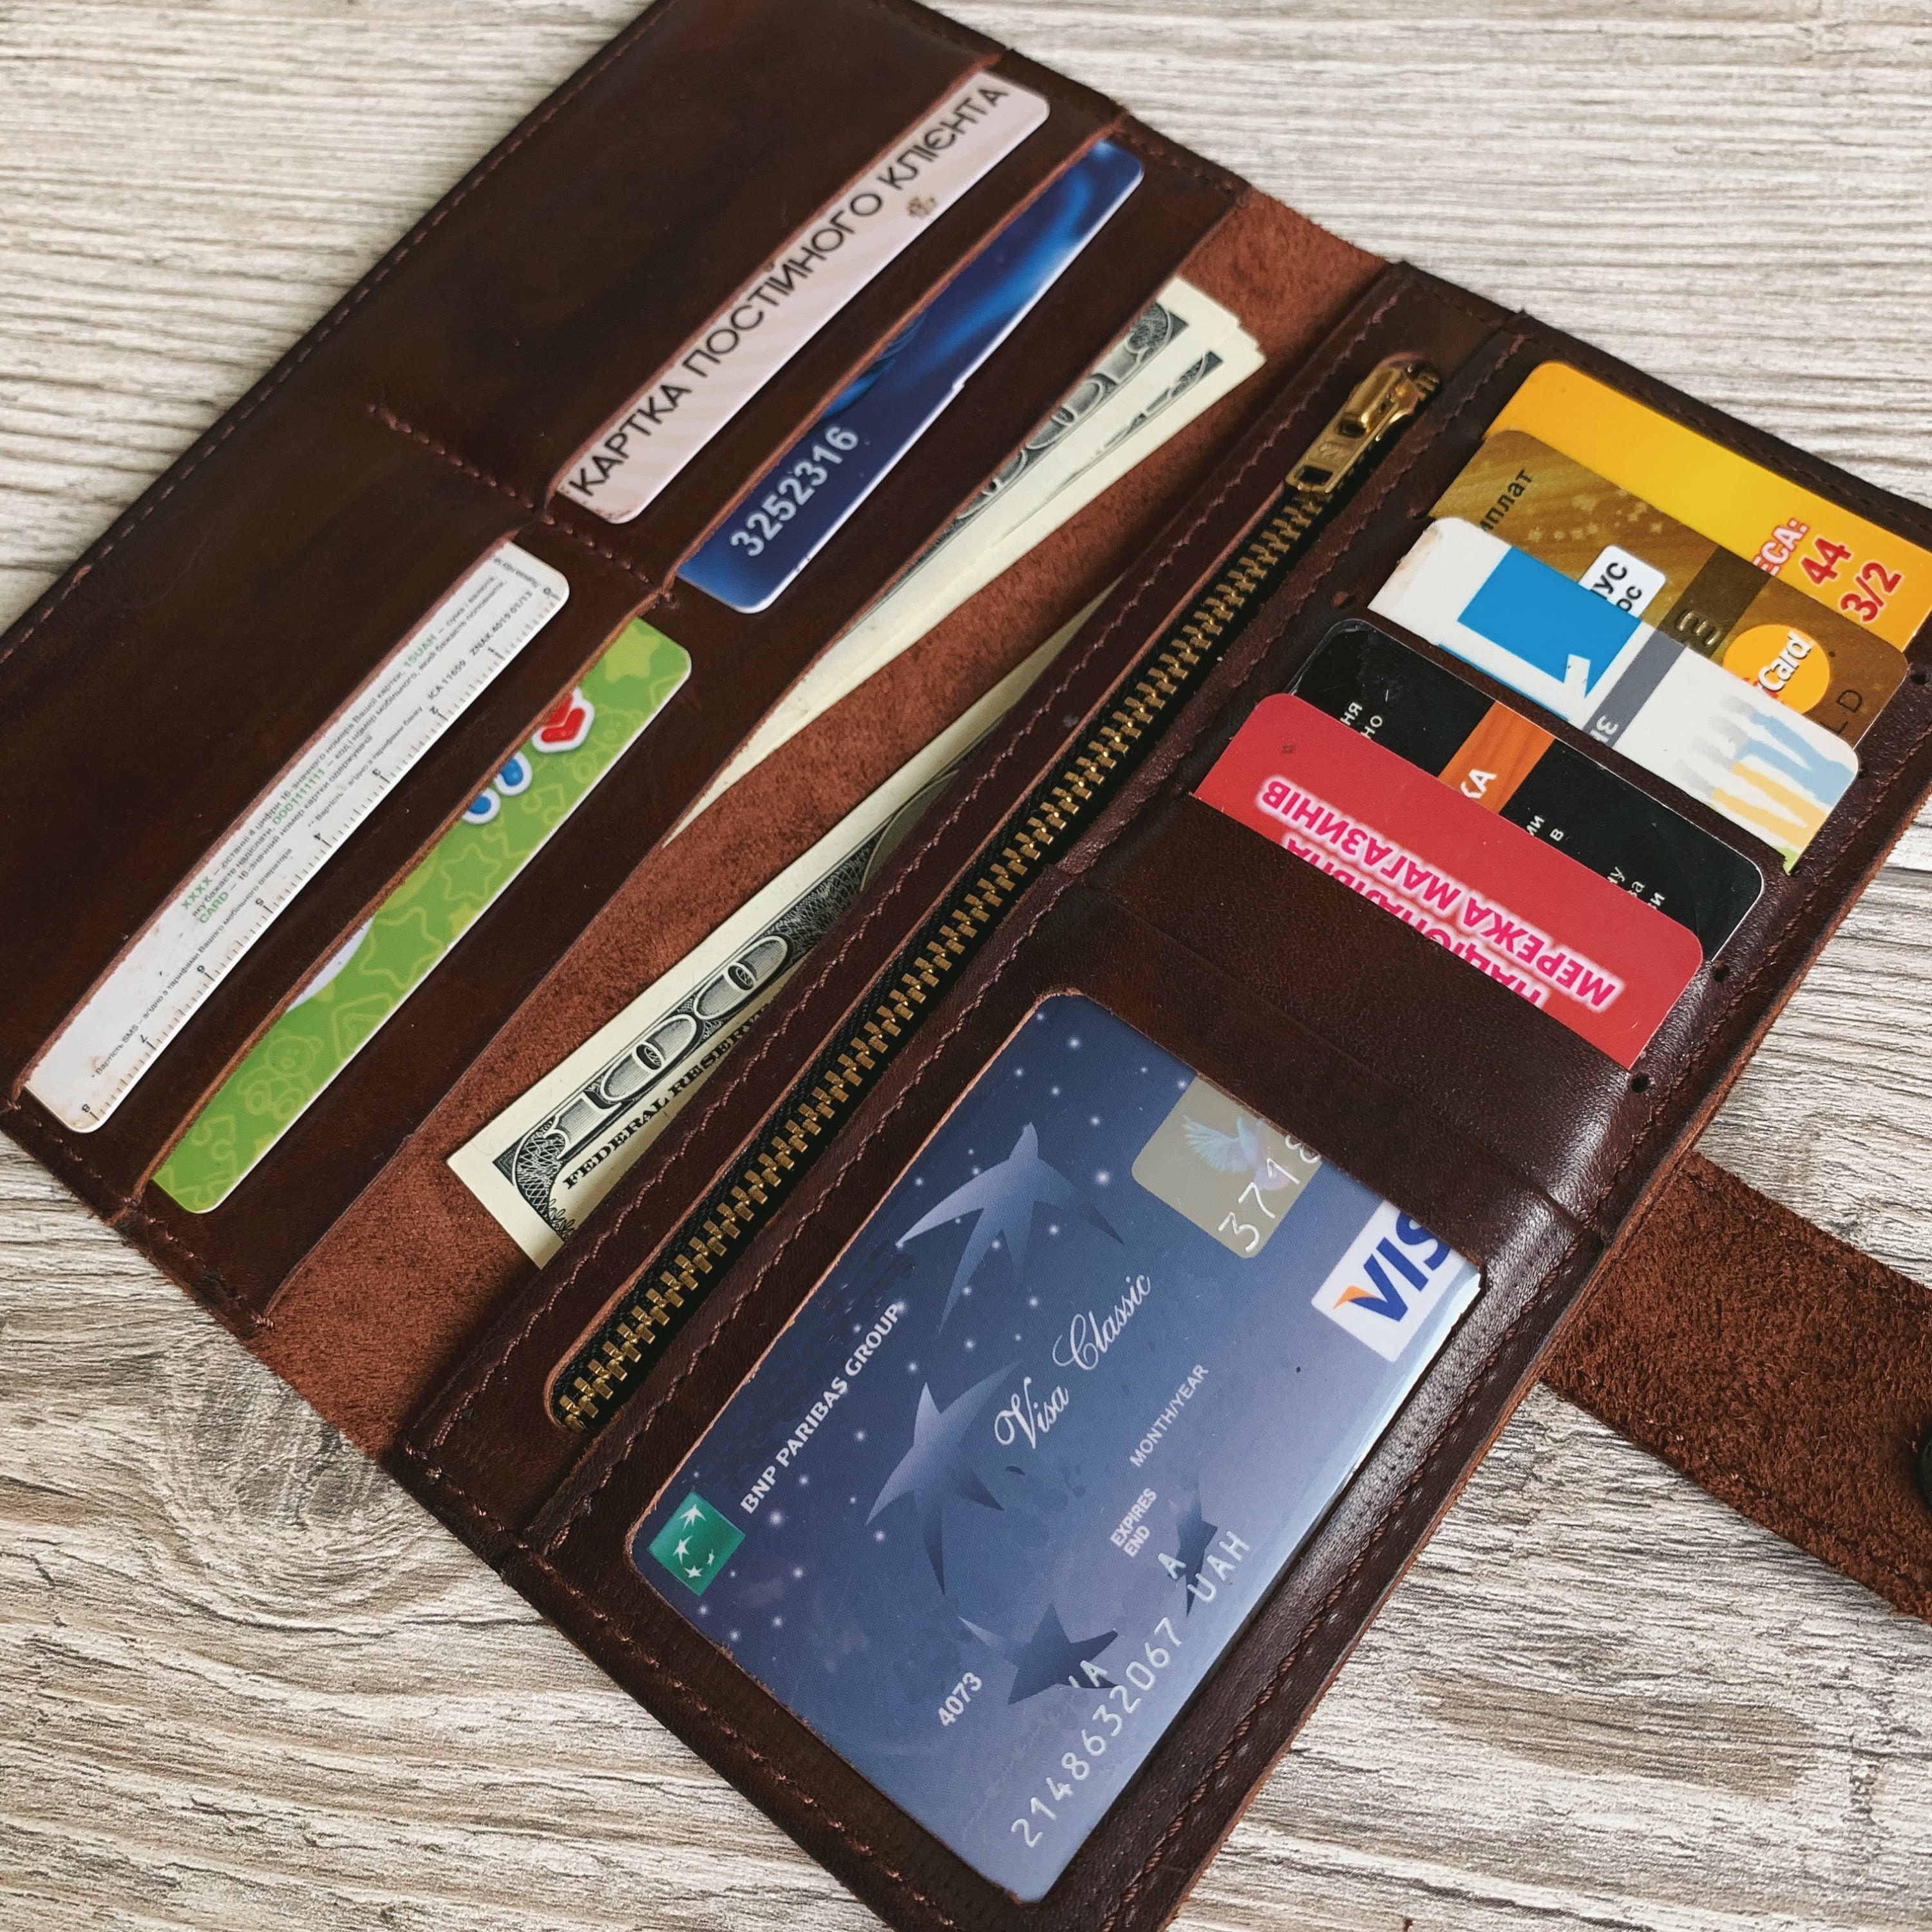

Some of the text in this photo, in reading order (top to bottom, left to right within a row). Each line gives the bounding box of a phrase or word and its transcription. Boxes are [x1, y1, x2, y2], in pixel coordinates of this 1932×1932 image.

[569, 86, 1010, 497] КАРТКА ПОСТІЙНОГО КЛІЄНТА
[730, 426, 859, 558] 3252316
[1800, 538, 1852, 586] 44
[1841, 562, 1904, 623] 3/2
[198, 891, 229, 924] CARD
[1262, 781, 1616, 1007] МЕРЕЖА МАГАЗИНІВ
[551, 934, 795, 1160] 100
[562, 1097, 671, 1189] FEDERAL
[740, 1304, 901, 1513] BNP PARIBAS GROUP
[994, 1273, 1151, 1449] Visa Classic
[1128, 1364, 1208, 1468] MONTH/YEAR
[1110, 1487, 1157, 1548] EXPIRES
[1123, 1524, 1150, 1557] END
[938, 1672, 982, 1725] 4073
[1011, 1531, 1249, 1848] 2148632067 UAH
